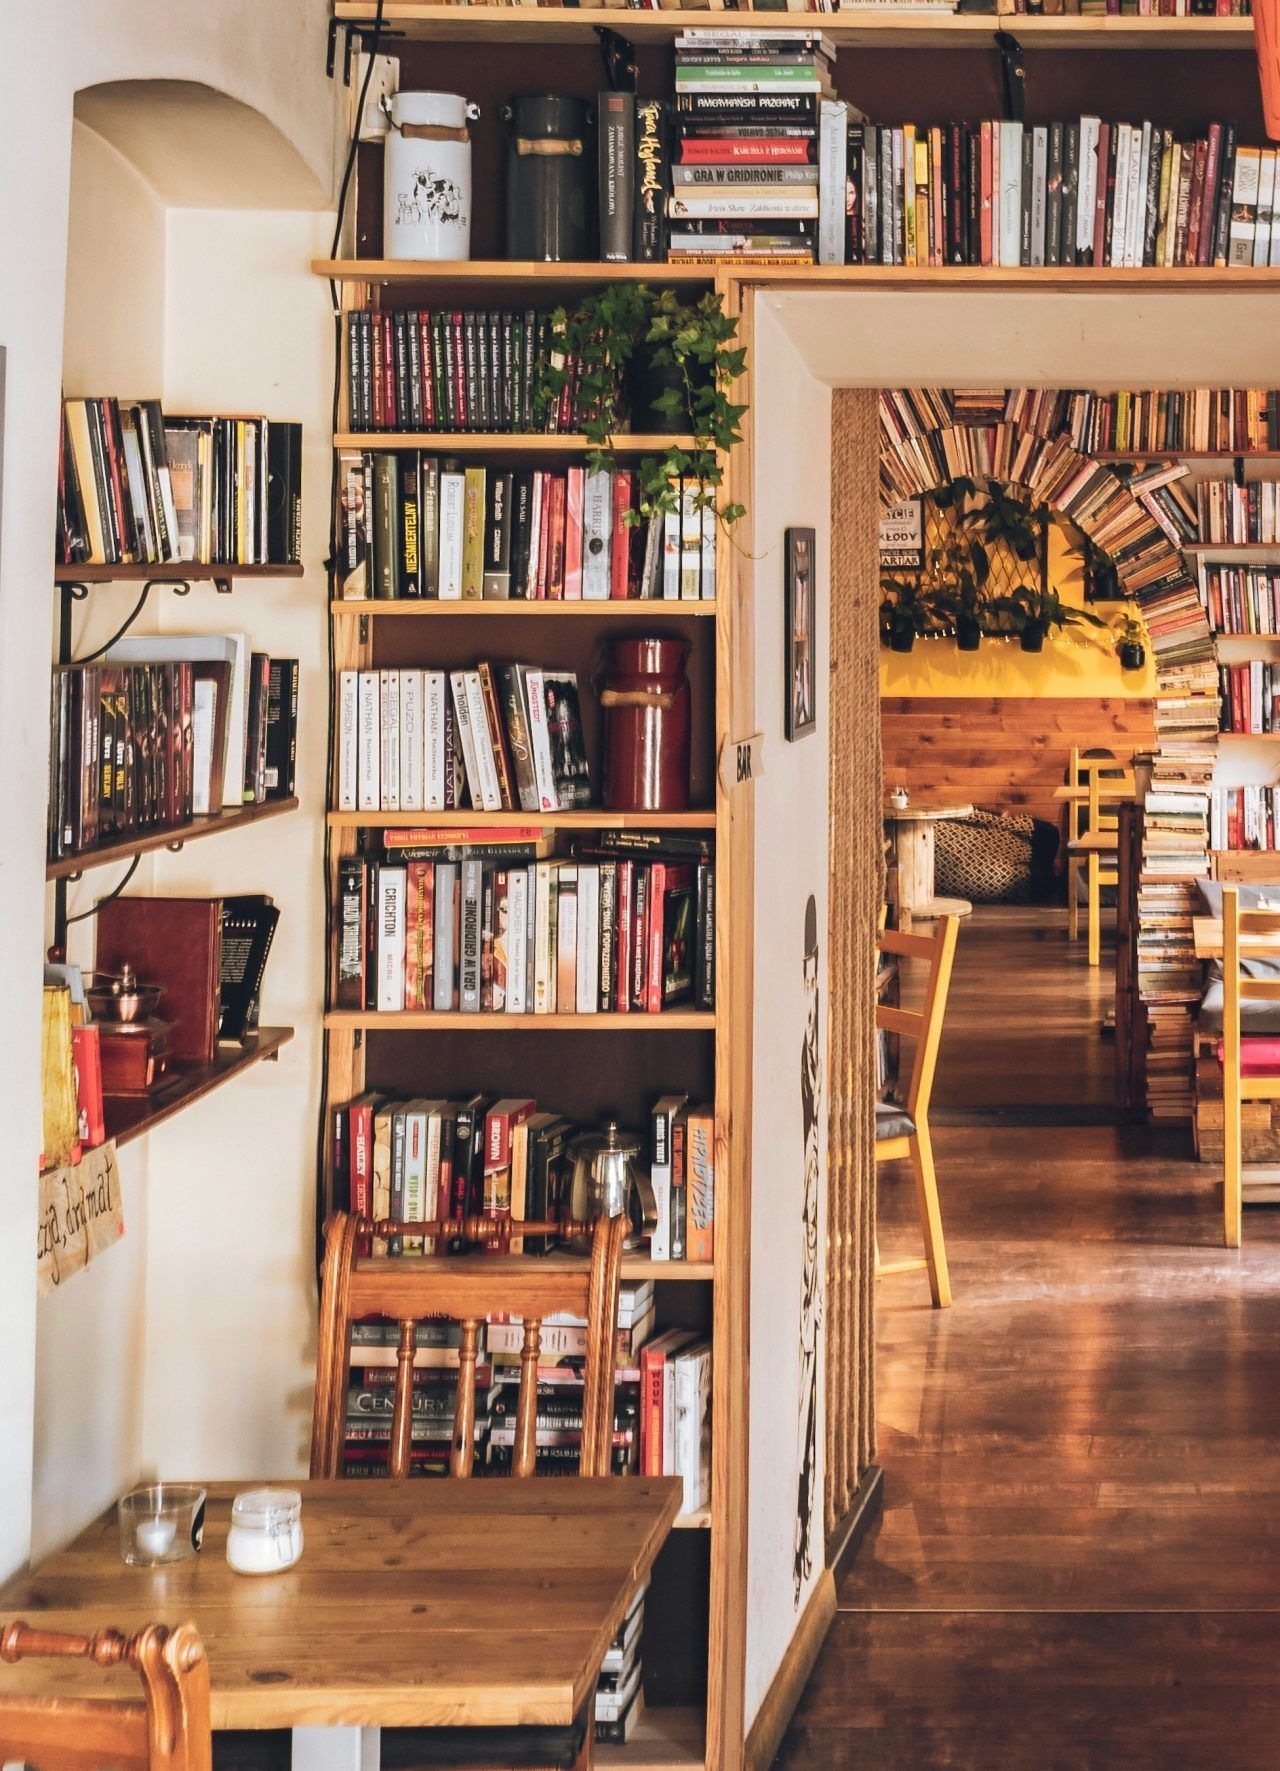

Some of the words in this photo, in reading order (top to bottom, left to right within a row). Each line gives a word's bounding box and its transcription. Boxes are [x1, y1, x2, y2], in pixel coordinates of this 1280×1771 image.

[697, 97, 756, 108] AMERYKAŃSKI
[759, 97, 801, 109] PRZEKRĘT
[616, 125, 624, 146] JORGE
[643, 105, 660, 135] Tara
[607, 126, 615, 178] ZAMASKOWANA
[637, 136, 663, 194] Hyland
[694, 170, 713, 182] GRA
[715, 170, 725, 181] W
[728, 170, 784, 182] GRIDIRONIE
[785, 170, 802, 181] Philip
[607, 180, 616, 215] KRÓLOWA
[1236, 243, 1247, 260] Gra
[446, 481, 459, 509] ROBERT
[495, 481, 504, 502] Wilbur
[519, 486, 527, 504] JOHN
[426, 490, 435, 532] Freeman
[494, 502, 503, 521] Smith
[519, 505, 527, 523] SAUL
[592, 495, 603, 535] HARRIS
[404, 502, 417, 573] NIEŚMIERTELNY
[364, 692, 372, 735] NATHAN
[405, 691, 415, 733] PUZO
[430, 692, 438, 735] NATHAN
[456, 693, 469, 727] holden
[446, 719, 455, 804] NATHAN
[736, 744, 752, 783] BAR
[602, 881, 612, 908] WYSPA
[384, 887, 397, 938] CRICHTON
[464, 899, 477, 956] GRIDIRONIE
[602, 910, 612, 931] DNIA
[635, 919, 643, 934] MAM
[705, 913, 714, 941] GANGSTER
[464, 959, 477, 968] W
[602, 932, 612, 992] POPRZEDNIEGO
[705, 942, 713, 960] SQUAD
[464, 969, 477, 991] GRA
[356, 1135, 366, 1176] HAILEY
[490, 1120, 500, 1160] BROWN
[356, 1393, 448, 1412] CENURY
[652, 1370, 661, 1407] WOUK
